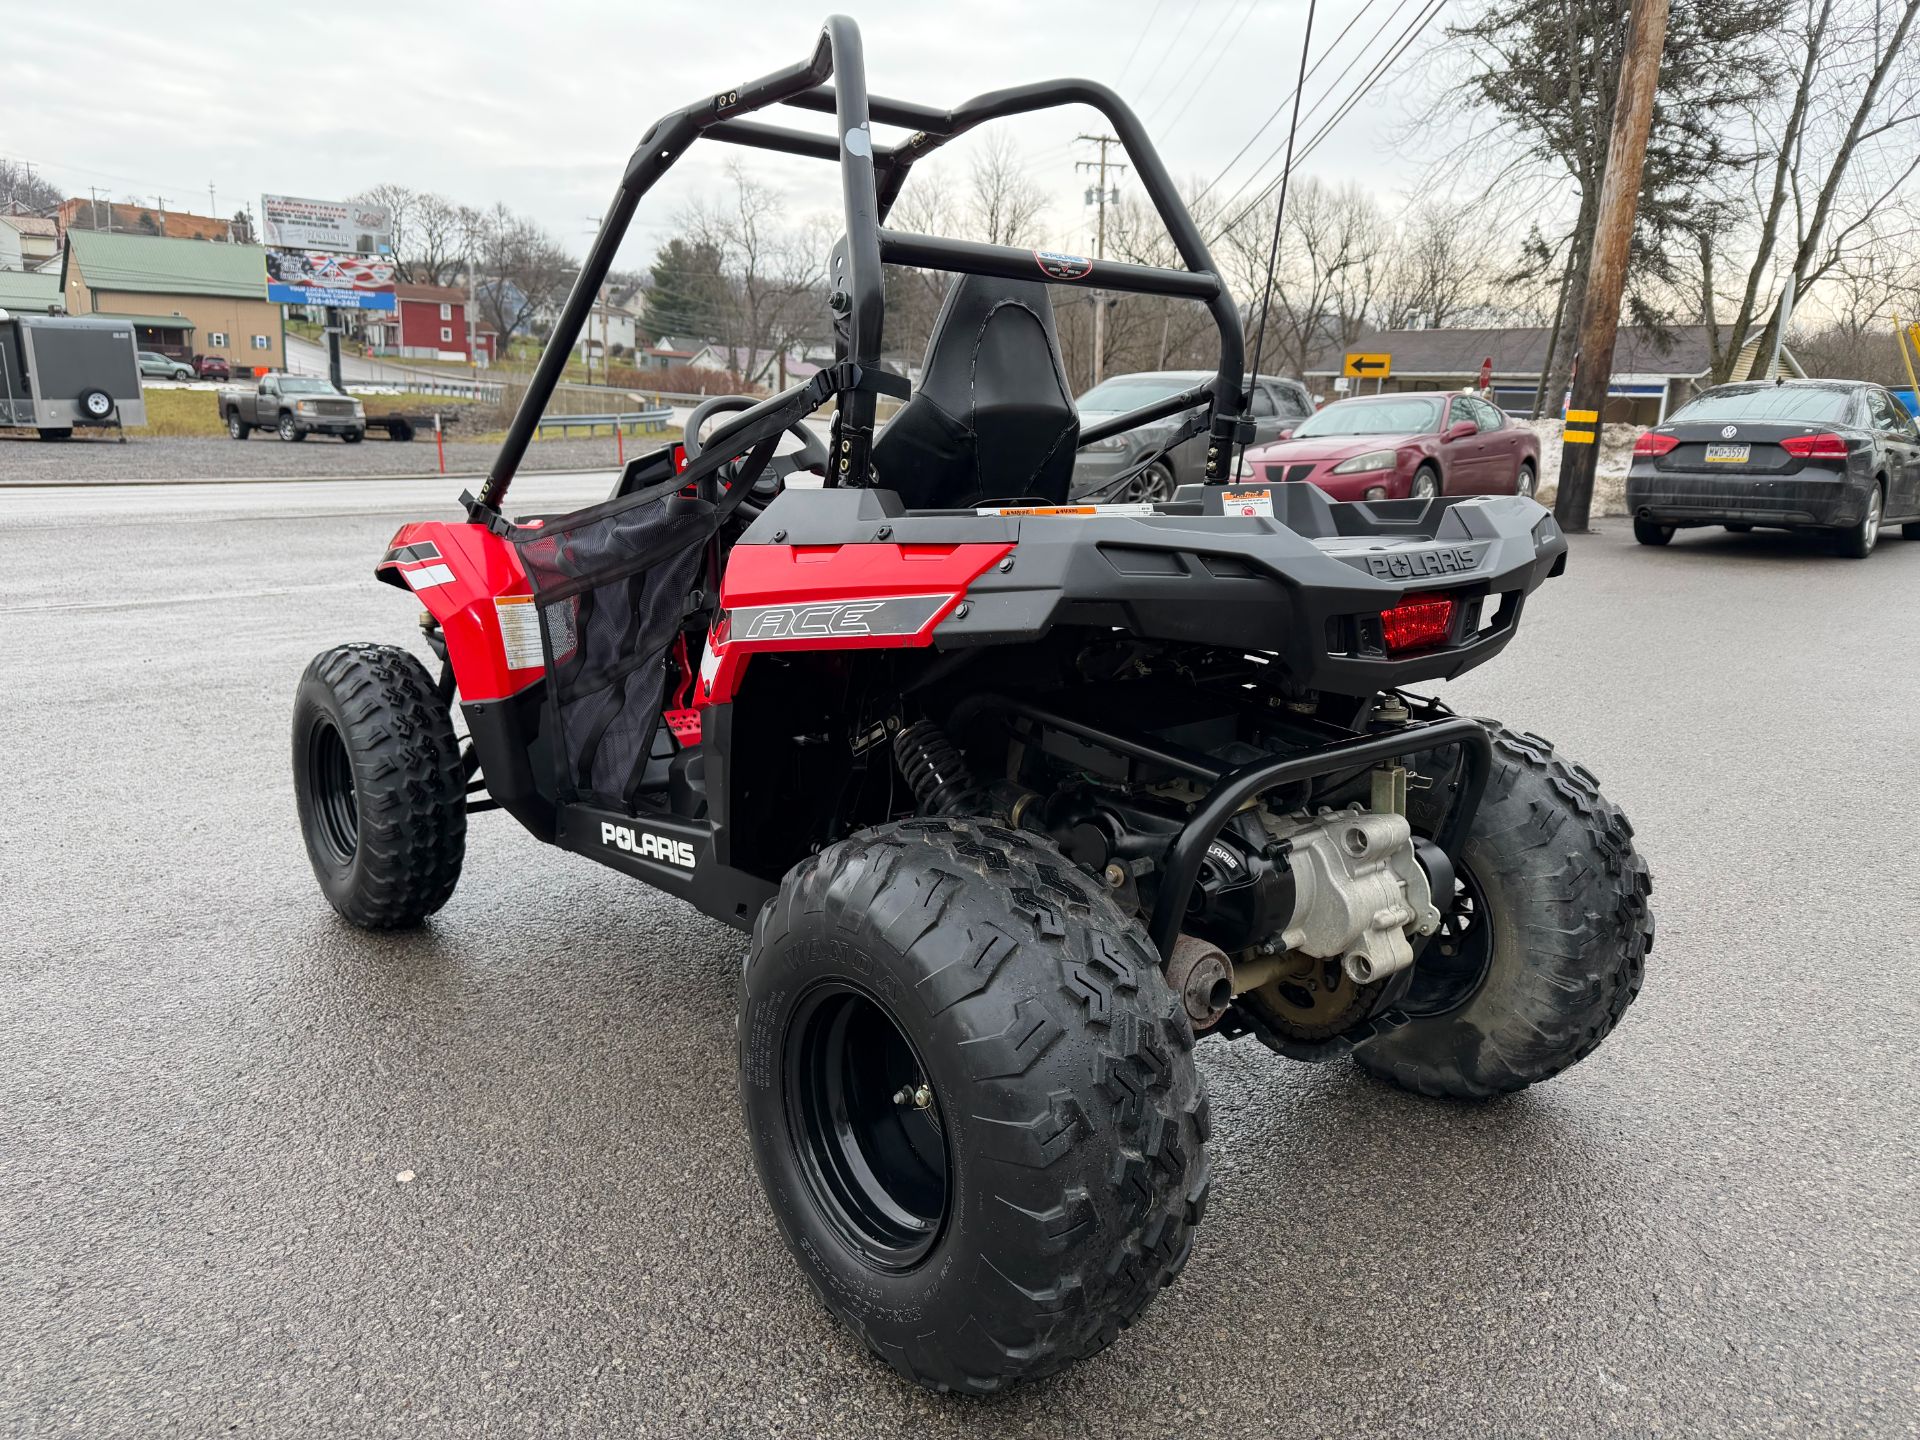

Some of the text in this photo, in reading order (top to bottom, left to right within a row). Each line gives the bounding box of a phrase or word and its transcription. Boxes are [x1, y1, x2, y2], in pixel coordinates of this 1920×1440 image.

[1366, 547, 1478, 577] POLARIS
[746, 602, 886, 638] ACE
[601, 821, 696, 868] POLARIS
[1207, 845, 1238, 869] LARIS
[784, 938, 899, 1004] WANDA
